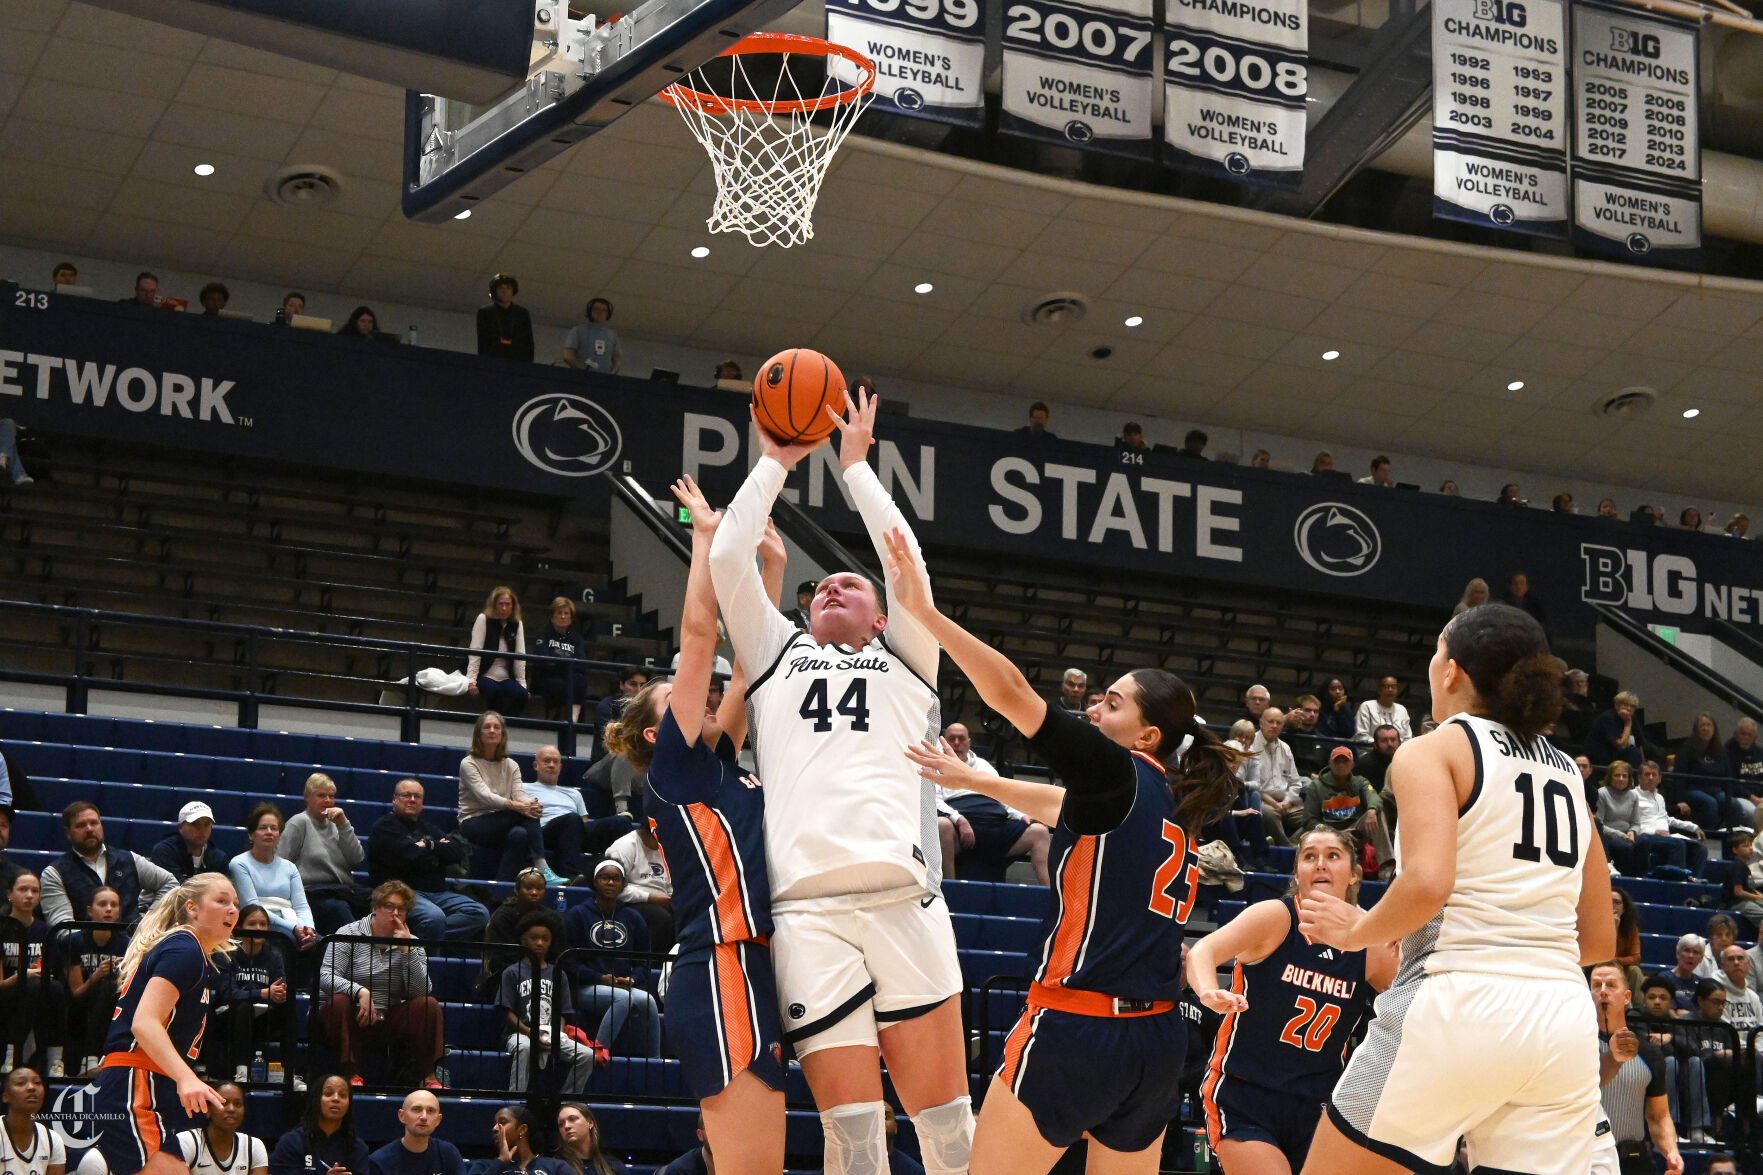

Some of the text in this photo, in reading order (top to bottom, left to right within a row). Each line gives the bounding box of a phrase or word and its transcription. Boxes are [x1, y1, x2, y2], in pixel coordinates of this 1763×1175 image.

[848, 0, 978, 28] 99
[1006, 5, 1152, 62] 2007
[1444, 18, 1558, 54] CHAMPIONS
[867, 40, 952, 71] WOMEN'S
[1168, 39, 1307, 96] 2008
[1450, 53, 1552, 83] 1992 1993
[1583, 50, 1689, 86] CHAMPIONS
[855, 59, 965, 92] LLEYBALL
[1039, 75, 1121, 103] WOMEN'S
[1450, 72, 1552, 102] 1996 1997
[1026, 90, 1132, 123] VOLLEYBALL
[1451, 91, 1552, 121] 1998 1999
[1585, 82, 1685, 112] 2005 2006
[1585, 97, 1686, 127] 2007 2008
[1200, 108, 1278, 136] WOMEN'S
[1449, 110, 1555, 141] 2003 2004
[1585, 112, 1684, 141] 2009 2010
[1187, 123, 1288, 155] VOLLEYBALL
[1587, 127, 1684, 156] 2012 2013
[1588, 142, 1687, 171] 2017 2024
[1466, 162, 1538, 187] WOMEN'S
[1456, 176, 1548, 206] VOLLEYBALL
[1604, 192, 1671, 216] WOMEN'S
[1593, 206, 1682, 234] VOLLEYBALL
[15, 291, 49, 310] 213
[1122, 451, 1144, 465] 214
[988, 456, 1243, 562] STATE
[582, 588, 594, 603] G
[612, 624, 622, 637] F
[785, 656, 890, 680] Penn State
[798, 677, 870, 733] 44
[1513, 772, 1579, 869] 10
[1147, 817, 1201, 925] 23
[1279, 995, 1342, 1052] 20
[305, 1154, 313, 1167] S
